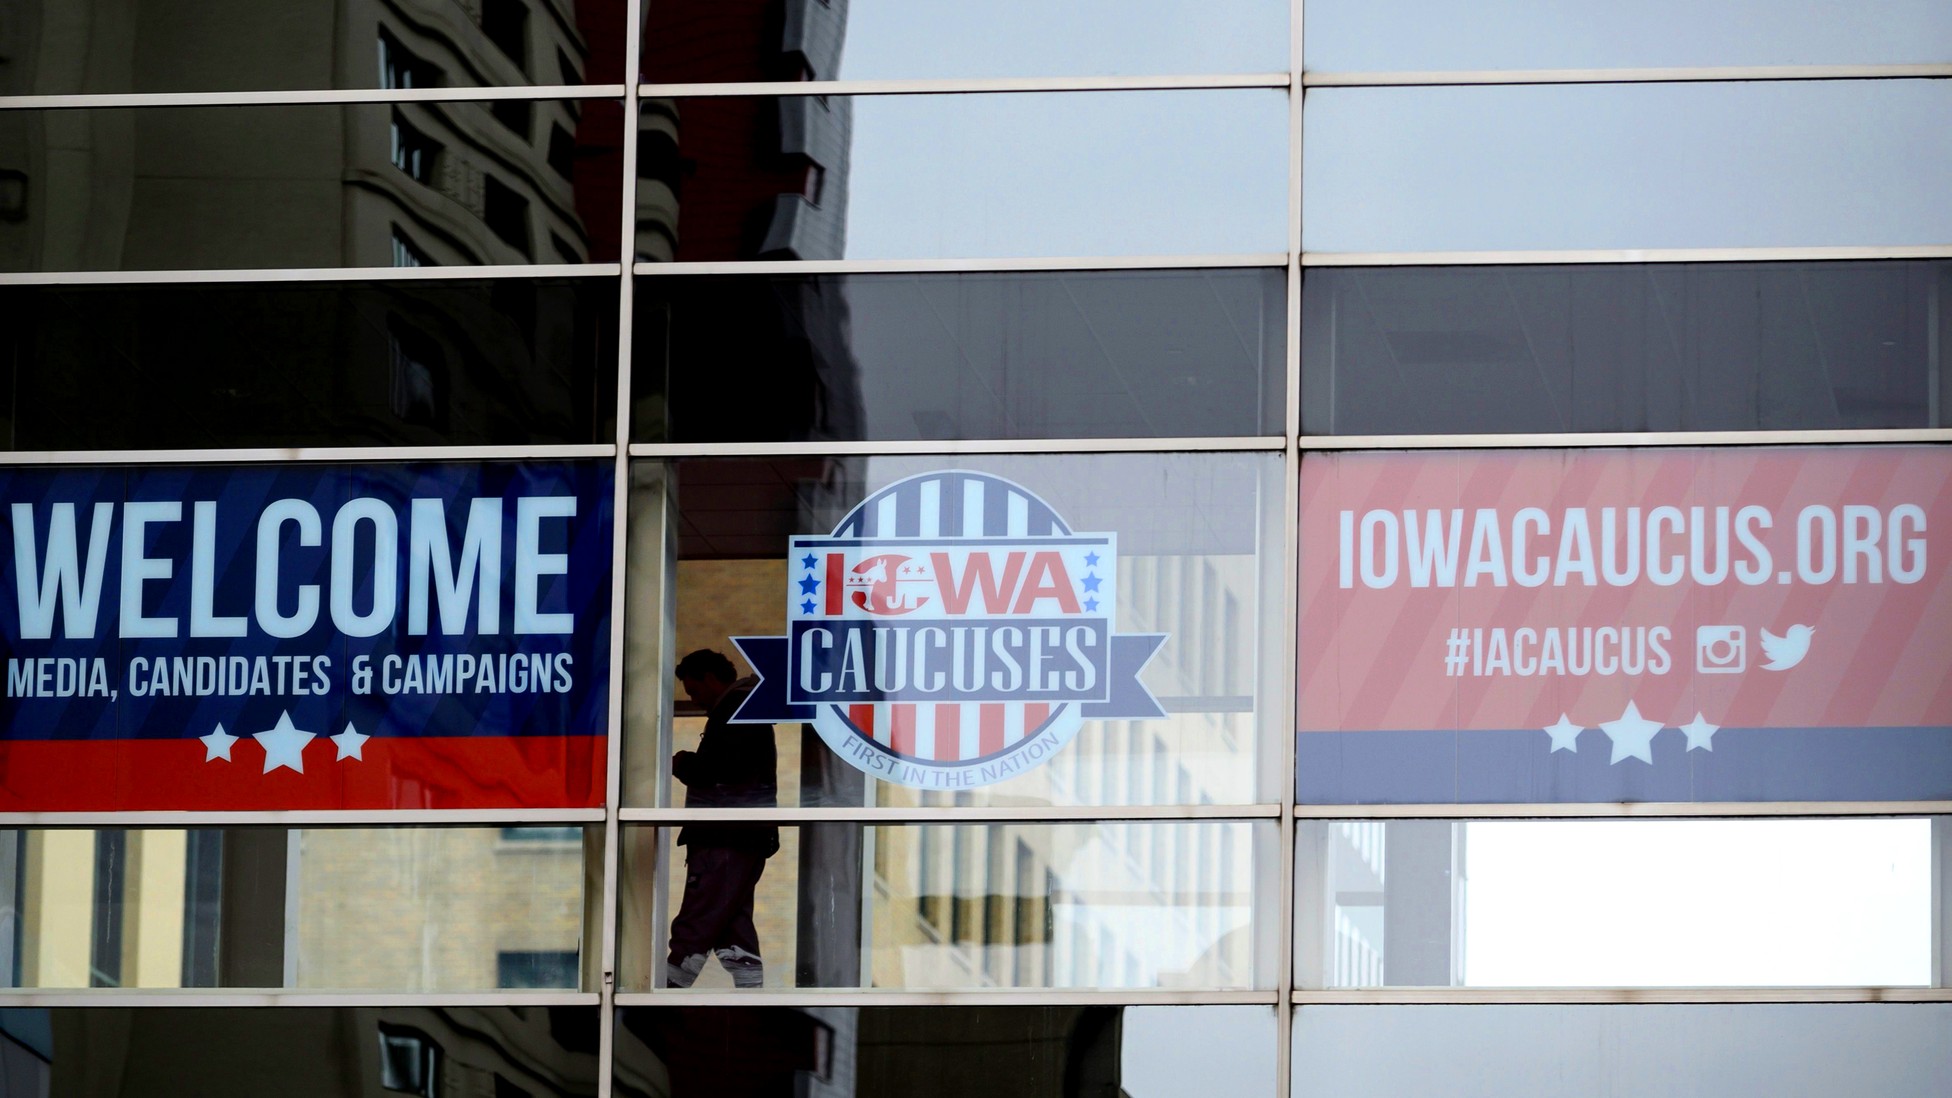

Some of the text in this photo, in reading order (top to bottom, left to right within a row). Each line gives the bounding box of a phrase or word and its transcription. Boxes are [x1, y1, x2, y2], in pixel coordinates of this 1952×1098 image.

[11, 496, 577, 639] WELCOME
[1339, 503, 1927, 589] IOWACAUCUS.ORG
[7, 653, 573, 702] MEDIA, CANDIDATES & CAMPAIGNS
[800, 626, 1097, 693] CAUCUSES
[1444, 625, 1672, 677] #IACAUCUS
[842, 732, 1060, 787] FIRST IN THE NATION
